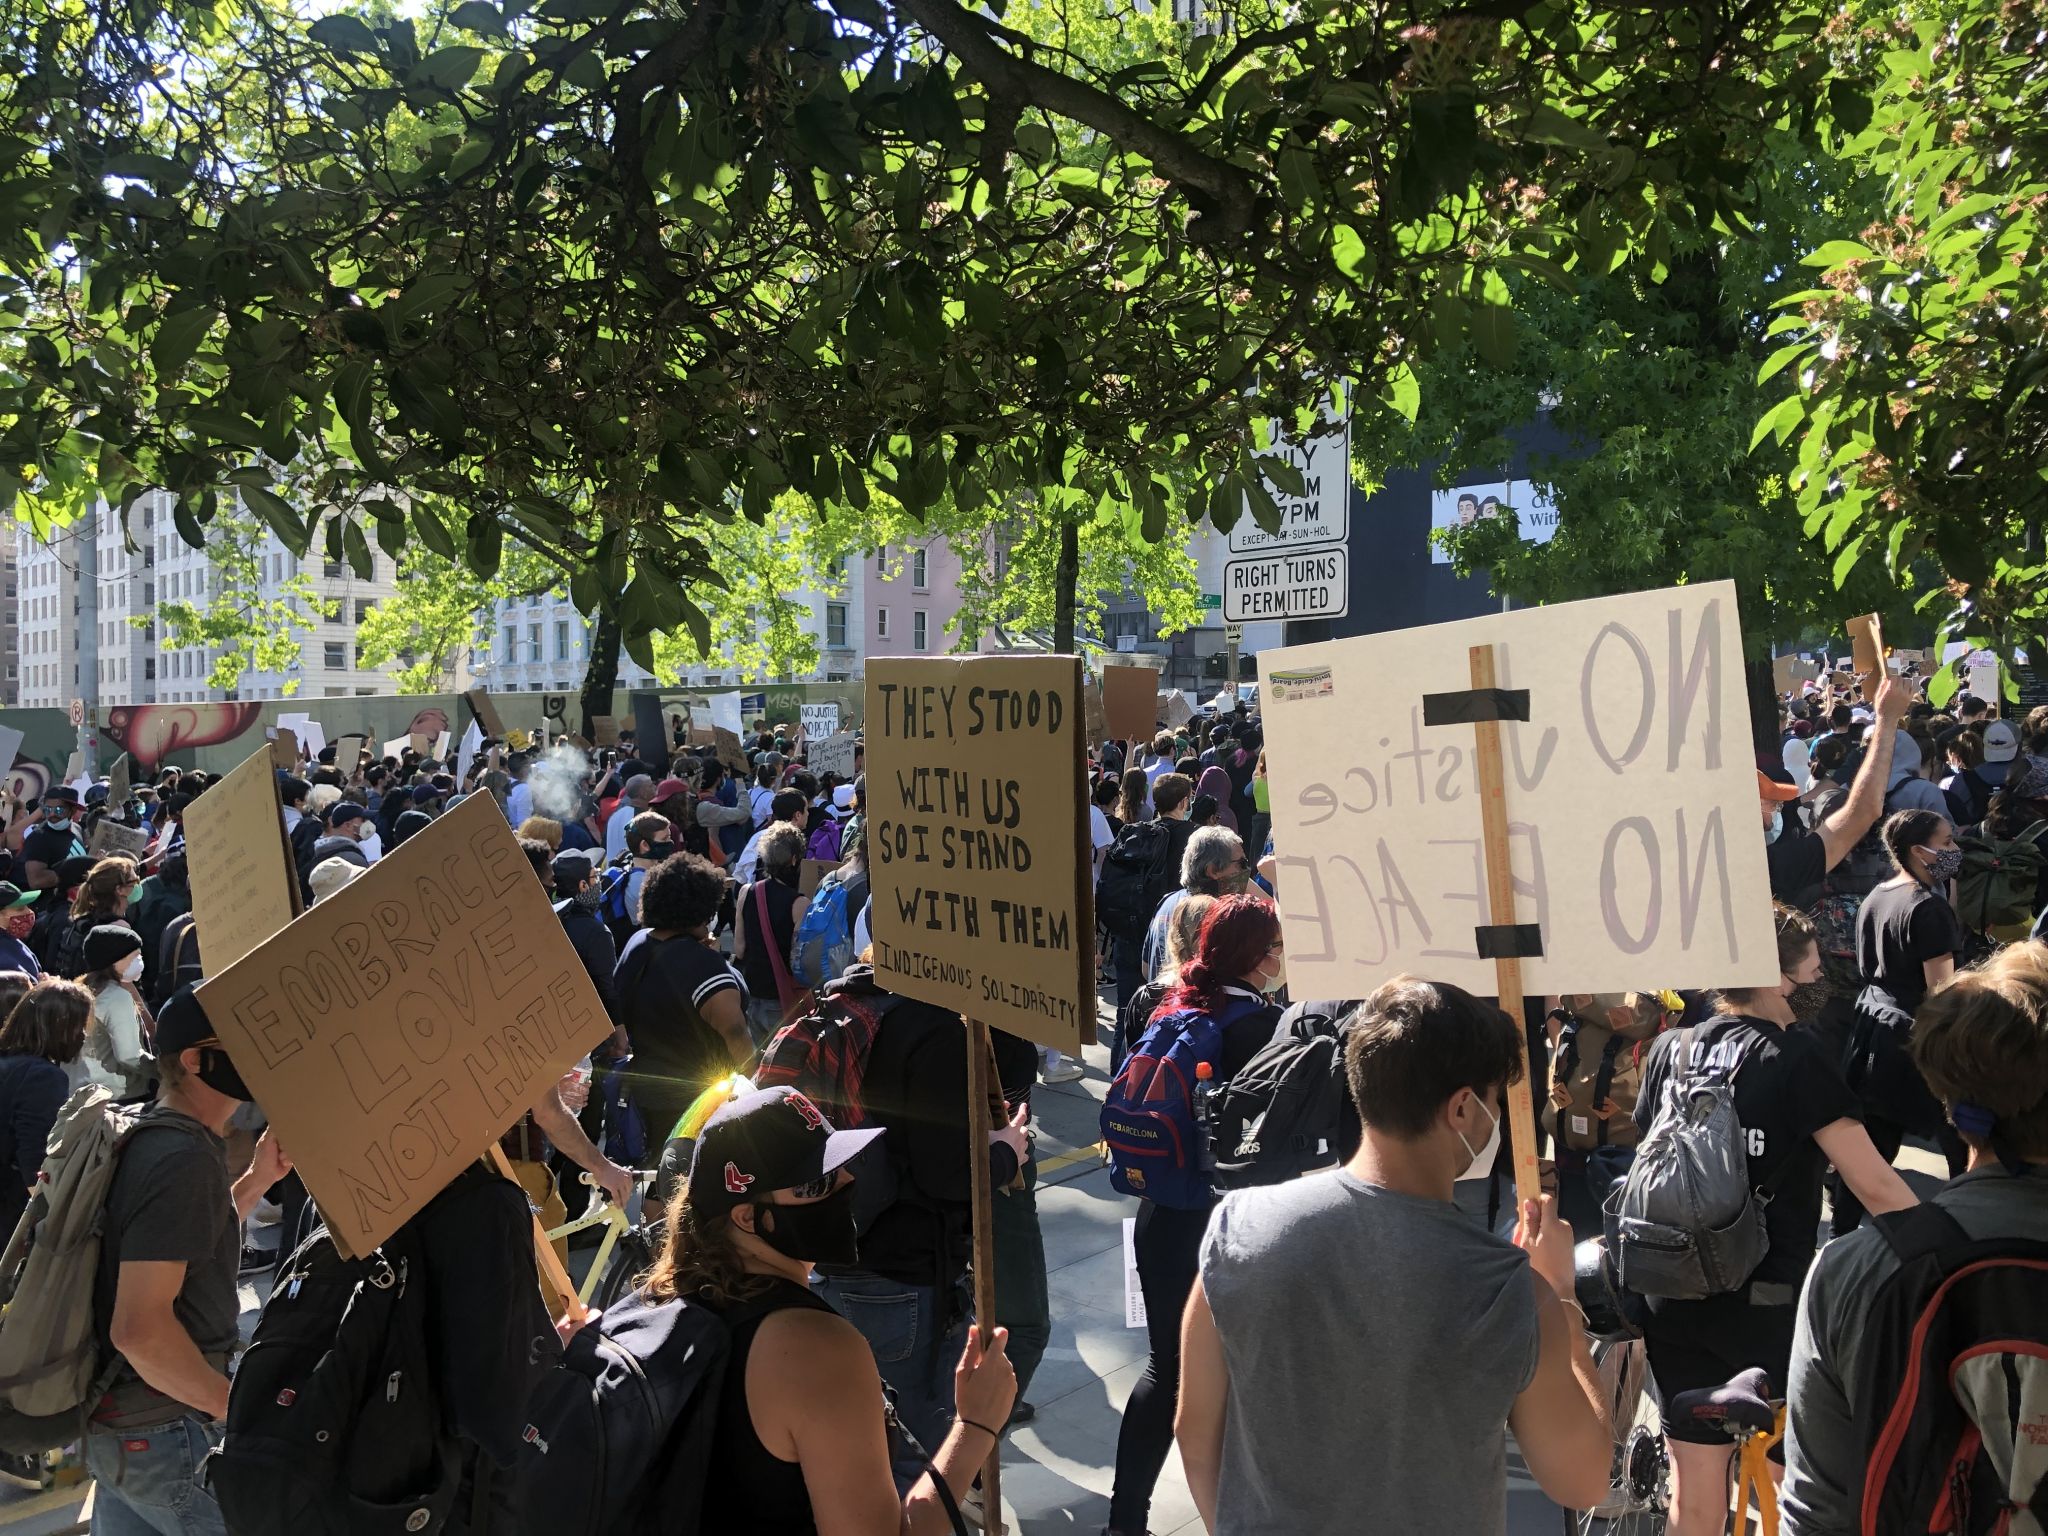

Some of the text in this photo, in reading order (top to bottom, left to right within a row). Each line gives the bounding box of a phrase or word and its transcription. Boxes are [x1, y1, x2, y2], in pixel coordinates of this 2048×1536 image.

[1234, 557, 1336, 589] RIGHT TURNS
[1241, 586, 1329, 614] PERMITTED
[1226, 624, 1242, 632] WAY
[802, 706, 837, 718] NO JUSTICE
[802, 721, 814, 735] NO
[879, 684, 1063, 739] THEY STOOD
[897, 767, 1020, 829] WITH US
[879, 820, 1032, 872] SO I STAND
[895, 886, 1070, 951] WITH THEM
[231, 824, 523, 1070] EMBRACE
[331, 906, 539, 1115] LOVE
[879, 940, 1077, 1028] INDIGENOUS SOLIDARITY
[338, 970, 594, 1234] NOT HATE
[783, 1092, 822, 1130] B
